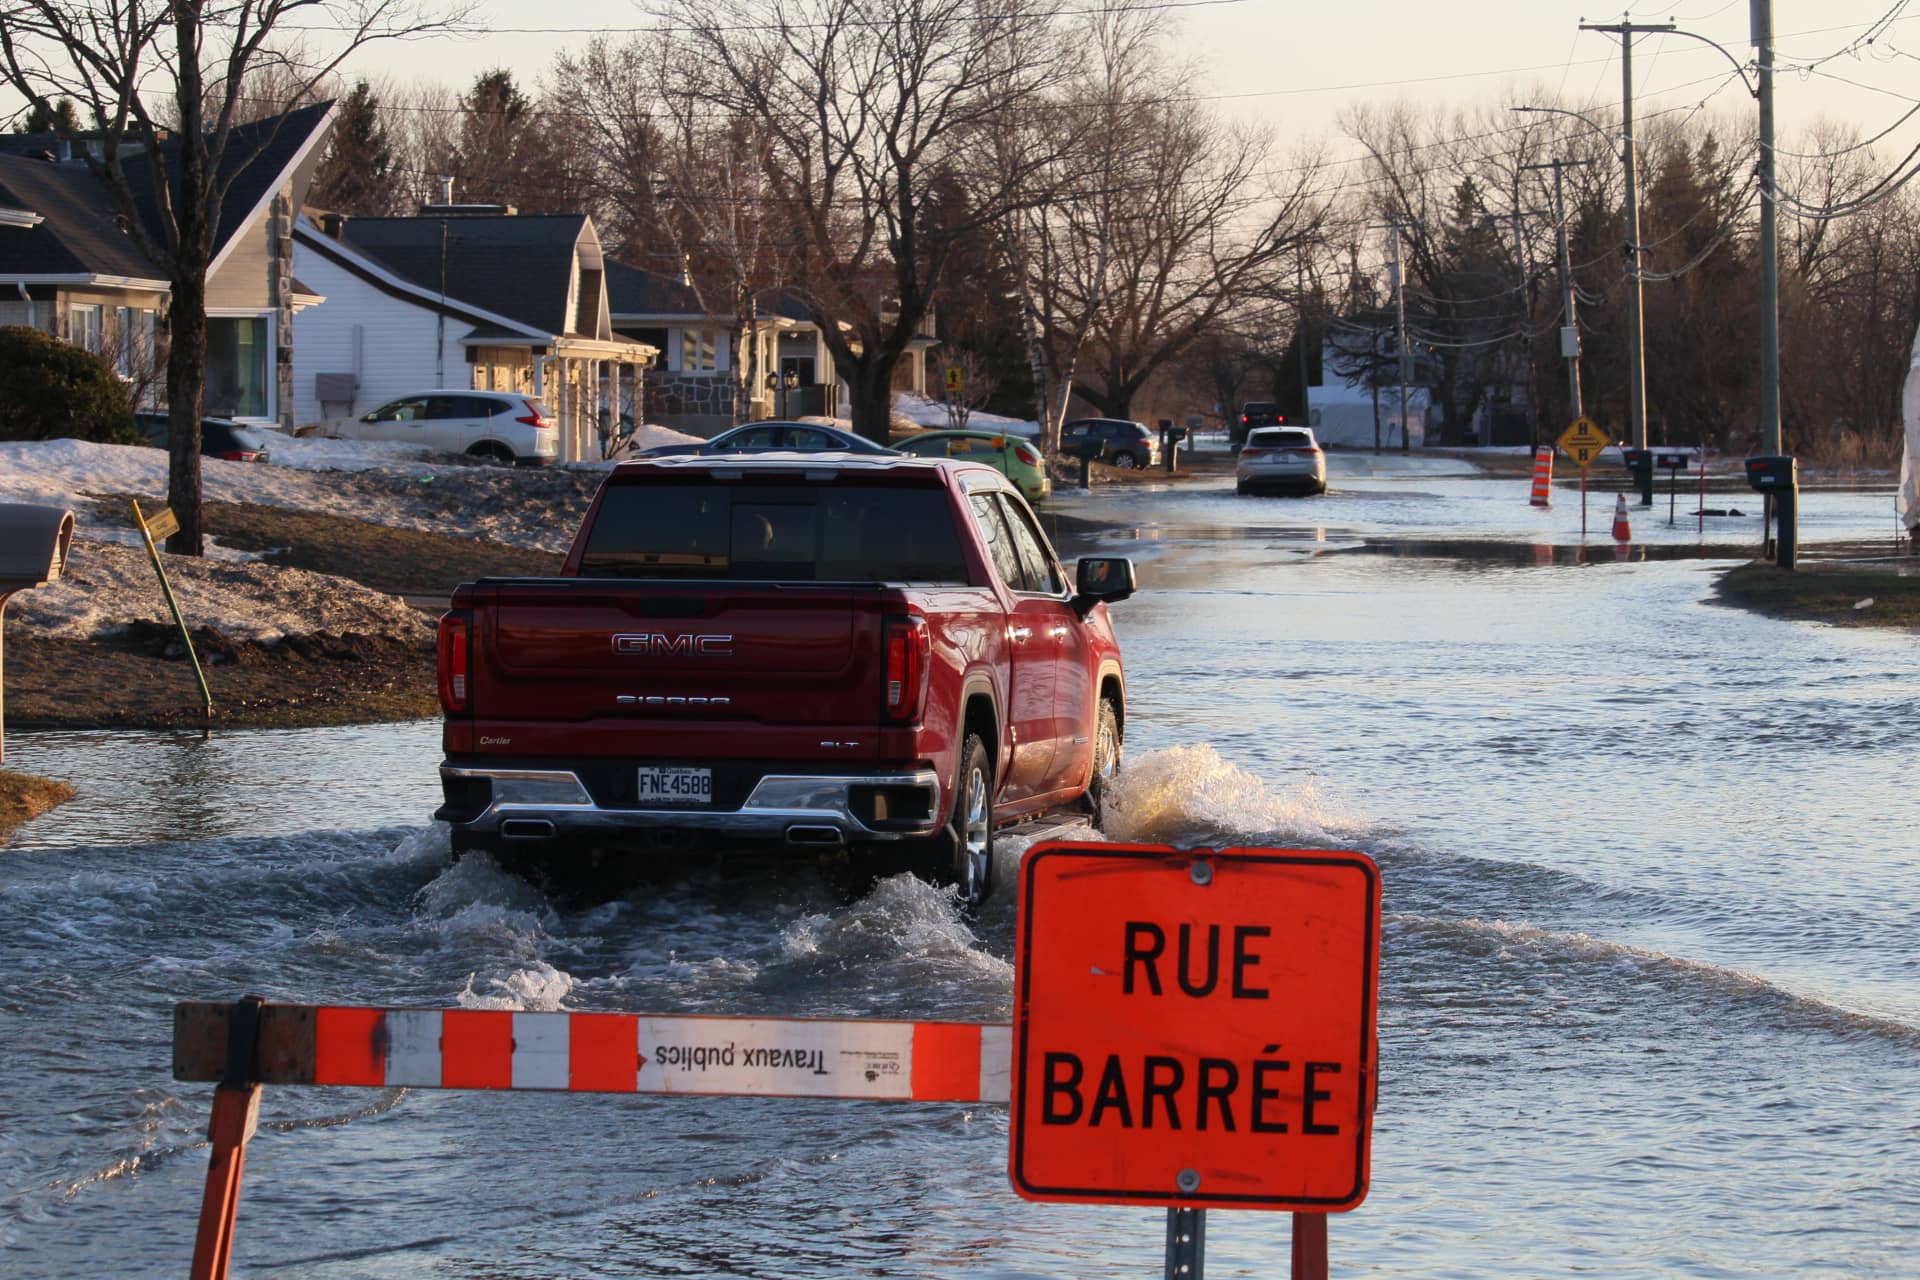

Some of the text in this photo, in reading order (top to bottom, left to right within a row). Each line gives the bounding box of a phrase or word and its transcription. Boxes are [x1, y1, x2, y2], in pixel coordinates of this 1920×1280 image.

[611, 633, 733, 656] GMC
[640, 774, 711, 794] FNE4588
[1122, 921, 1271, 1000] RUE
[655, 1042, 829, 1075] Travaux publics
[1042, 1044, 1341, 1135] BARRÉE
